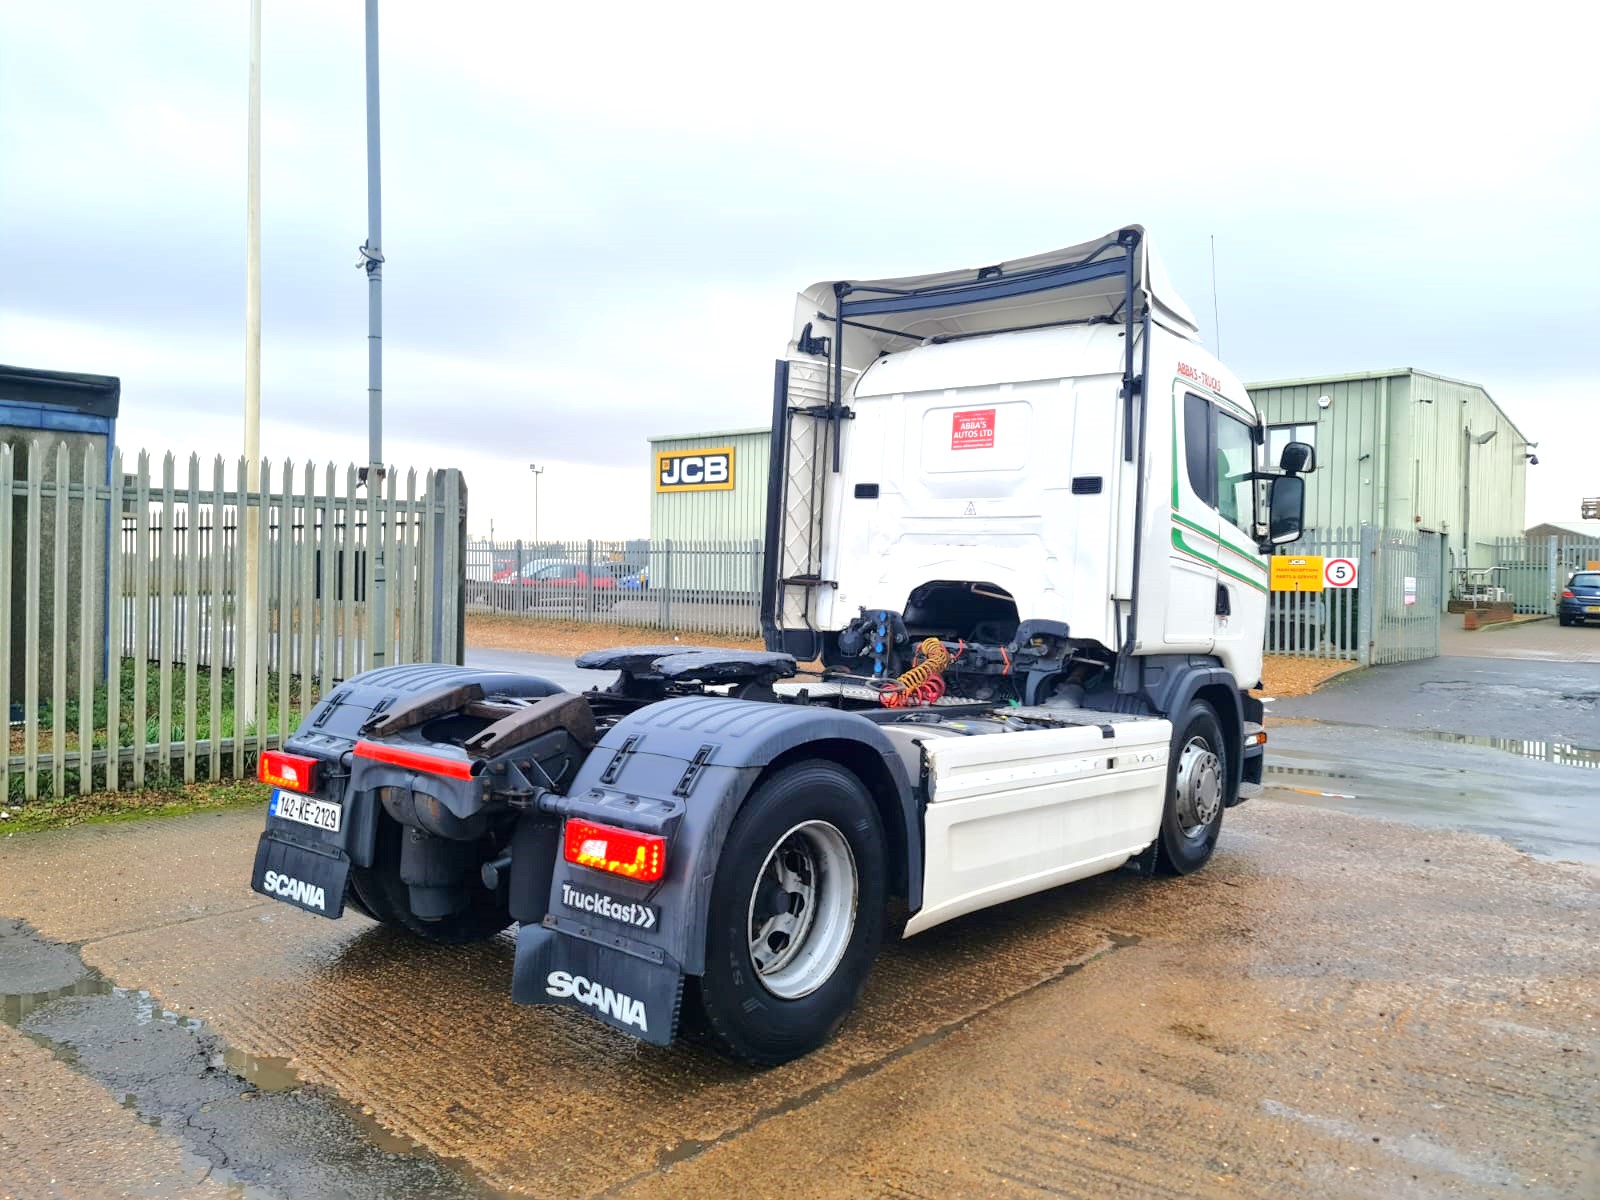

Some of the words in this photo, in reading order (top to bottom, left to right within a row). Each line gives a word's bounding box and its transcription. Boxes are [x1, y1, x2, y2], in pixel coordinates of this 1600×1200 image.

[953, 430, 978, 439] AUTOS
[979, 429, 993, 437] LTD
[960, 421, 987, 430] ABBA'S
[661, 455, 728, 484] JCB
[1335, 566, 1346, 579] 5
[280, 796, 337, 829] 142-KE-2129
[263, 870, 326, 911] SCANIA
[562, 884, 637, 926] TruckEast
[545, 970, 648, 1033] SCANIA
